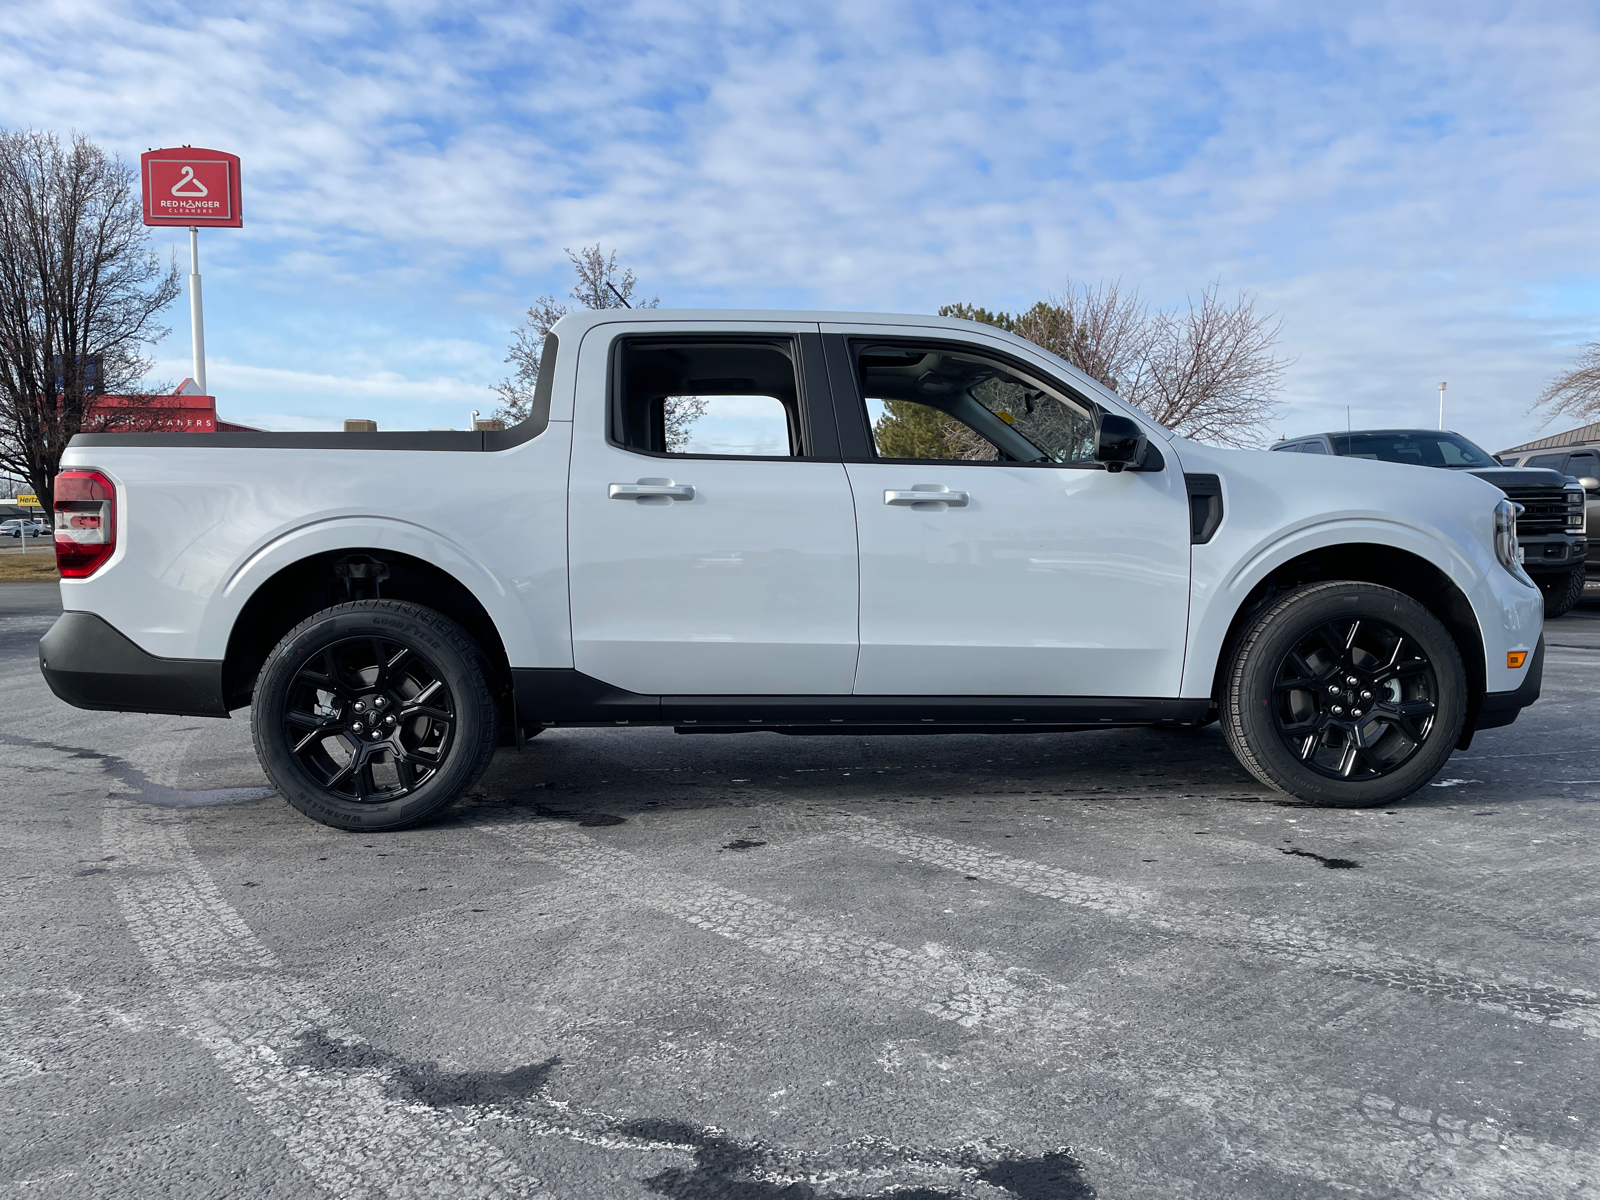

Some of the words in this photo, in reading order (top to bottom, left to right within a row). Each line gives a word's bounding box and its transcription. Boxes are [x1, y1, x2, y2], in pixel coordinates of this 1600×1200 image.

[180, 200, 220, 208] HANGER
[372, 616, 441, 650] GOODYEAR
[296, 792, 361, 824] WRANGLER
